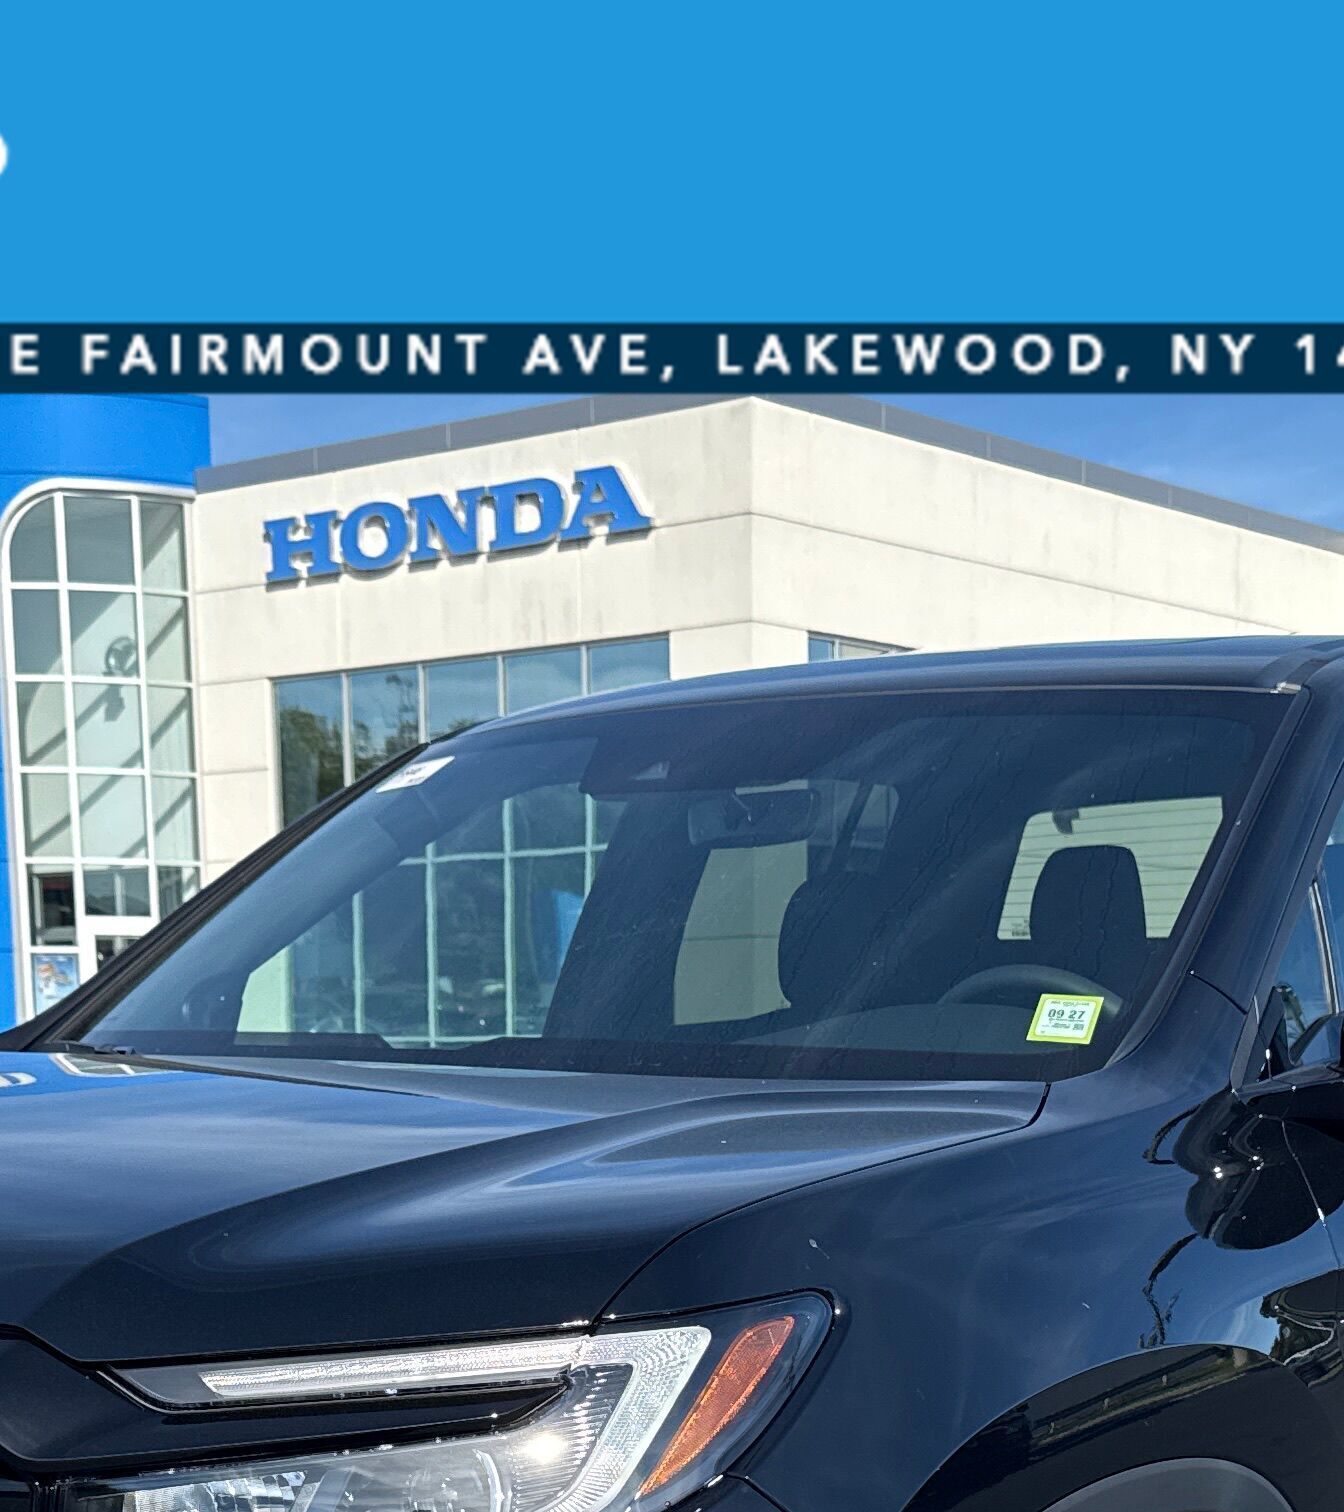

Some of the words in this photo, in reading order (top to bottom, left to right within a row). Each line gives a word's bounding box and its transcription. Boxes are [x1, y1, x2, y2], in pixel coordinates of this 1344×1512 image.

[263, 465, 653, 582] HONDA
[1047, 1008, 1065, 1019] 09
[1067, 1010, 1086, 1020] 27
